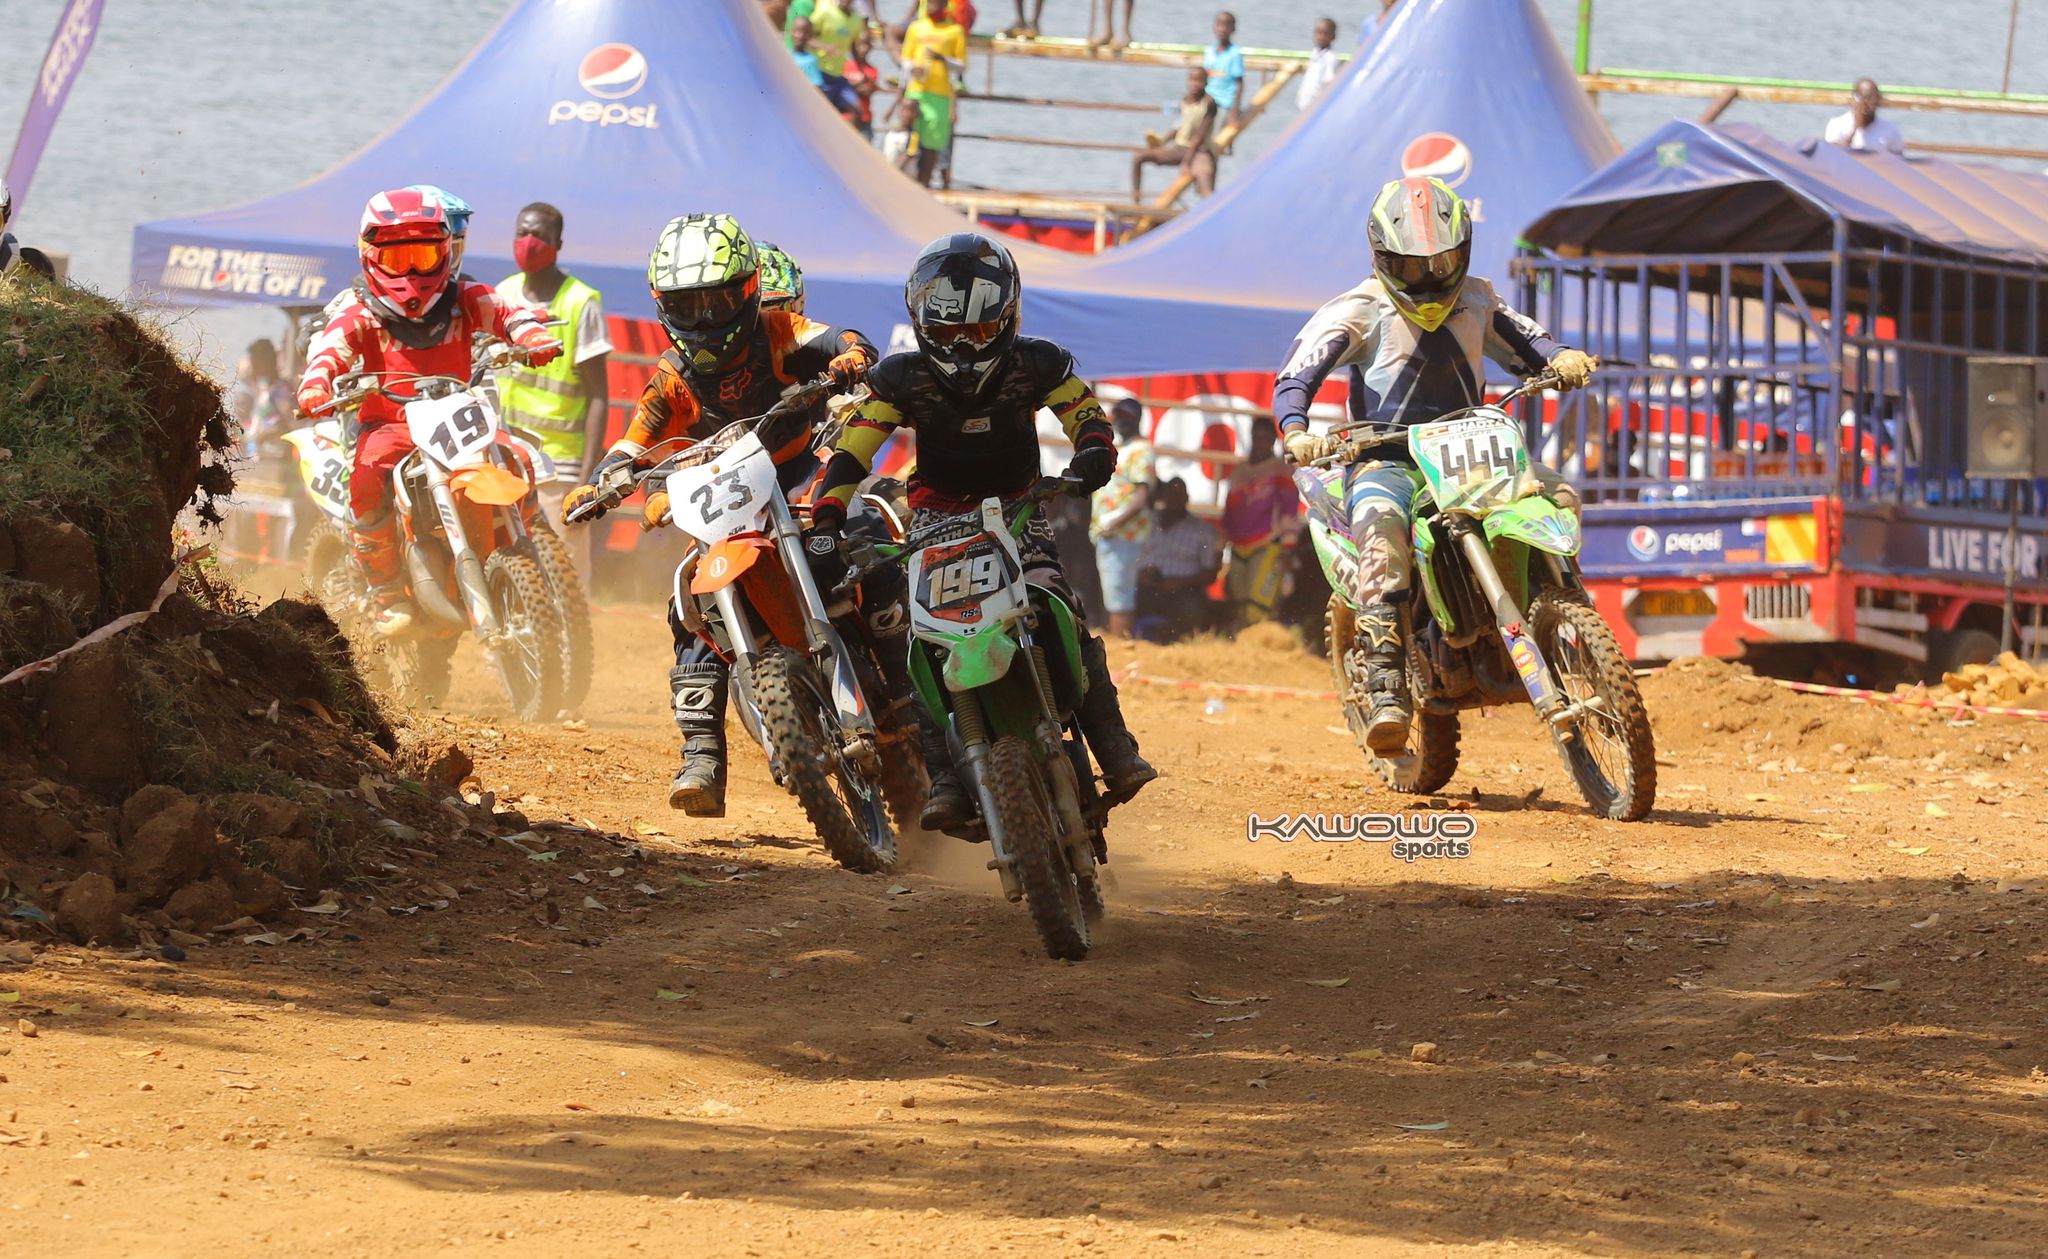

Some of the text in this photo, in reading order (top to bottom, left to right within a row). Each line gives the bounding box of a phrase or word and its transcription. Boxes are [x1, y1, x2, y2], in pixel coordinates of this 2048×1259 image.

[548, 100, 660, 129] pepsi
[167, 245, 265, 274] FOR THE
[200, 267, 328, 300] LOVE OF IT
[429, 400, 490, 462] 19
[1440, 435, 1516, 486] 444
[690, 465, 753, 525] 23
[1664, 528, 1724, 556] pepsi
[1928, 526, 2040, 579] LIVE FOR
[926, 553, 1002, 610] 199
